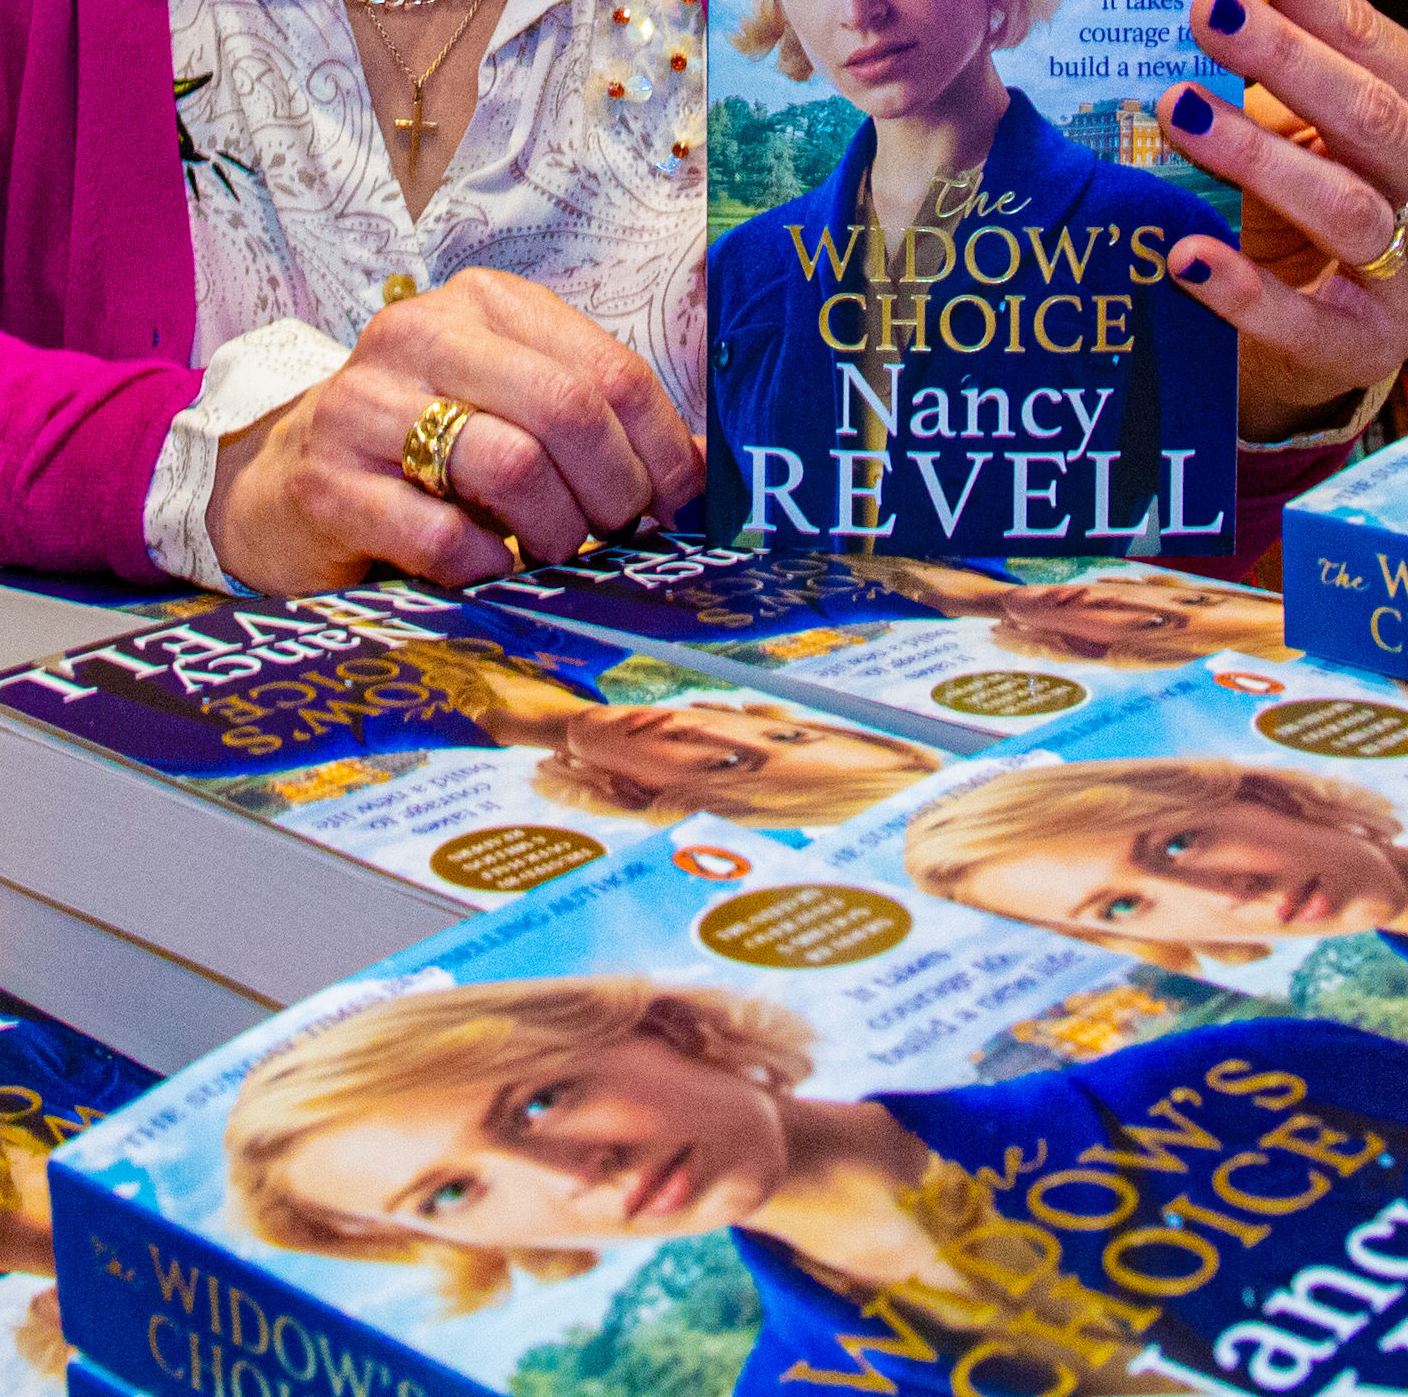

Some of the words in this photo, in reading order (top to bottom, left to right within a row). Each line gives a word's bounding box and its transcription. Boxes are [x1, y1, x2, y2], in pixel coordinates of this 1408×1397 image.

[1079, 25, 1172, 51] courage
[1049, 56, 1110, 78] build
[1117, 64, 1130, 78] a
[1137, 64, 1185, 78] new
[931, 171, 1032, 218] The
[783, 223, 1167, 286] WIDOW'S
[818, 293, 1135, 354] CHOICE
[835, 362, 1114, 462] Nancy
[742, 445, 1224, 540] REVELL
[1317, 557, 1370, 592] The
